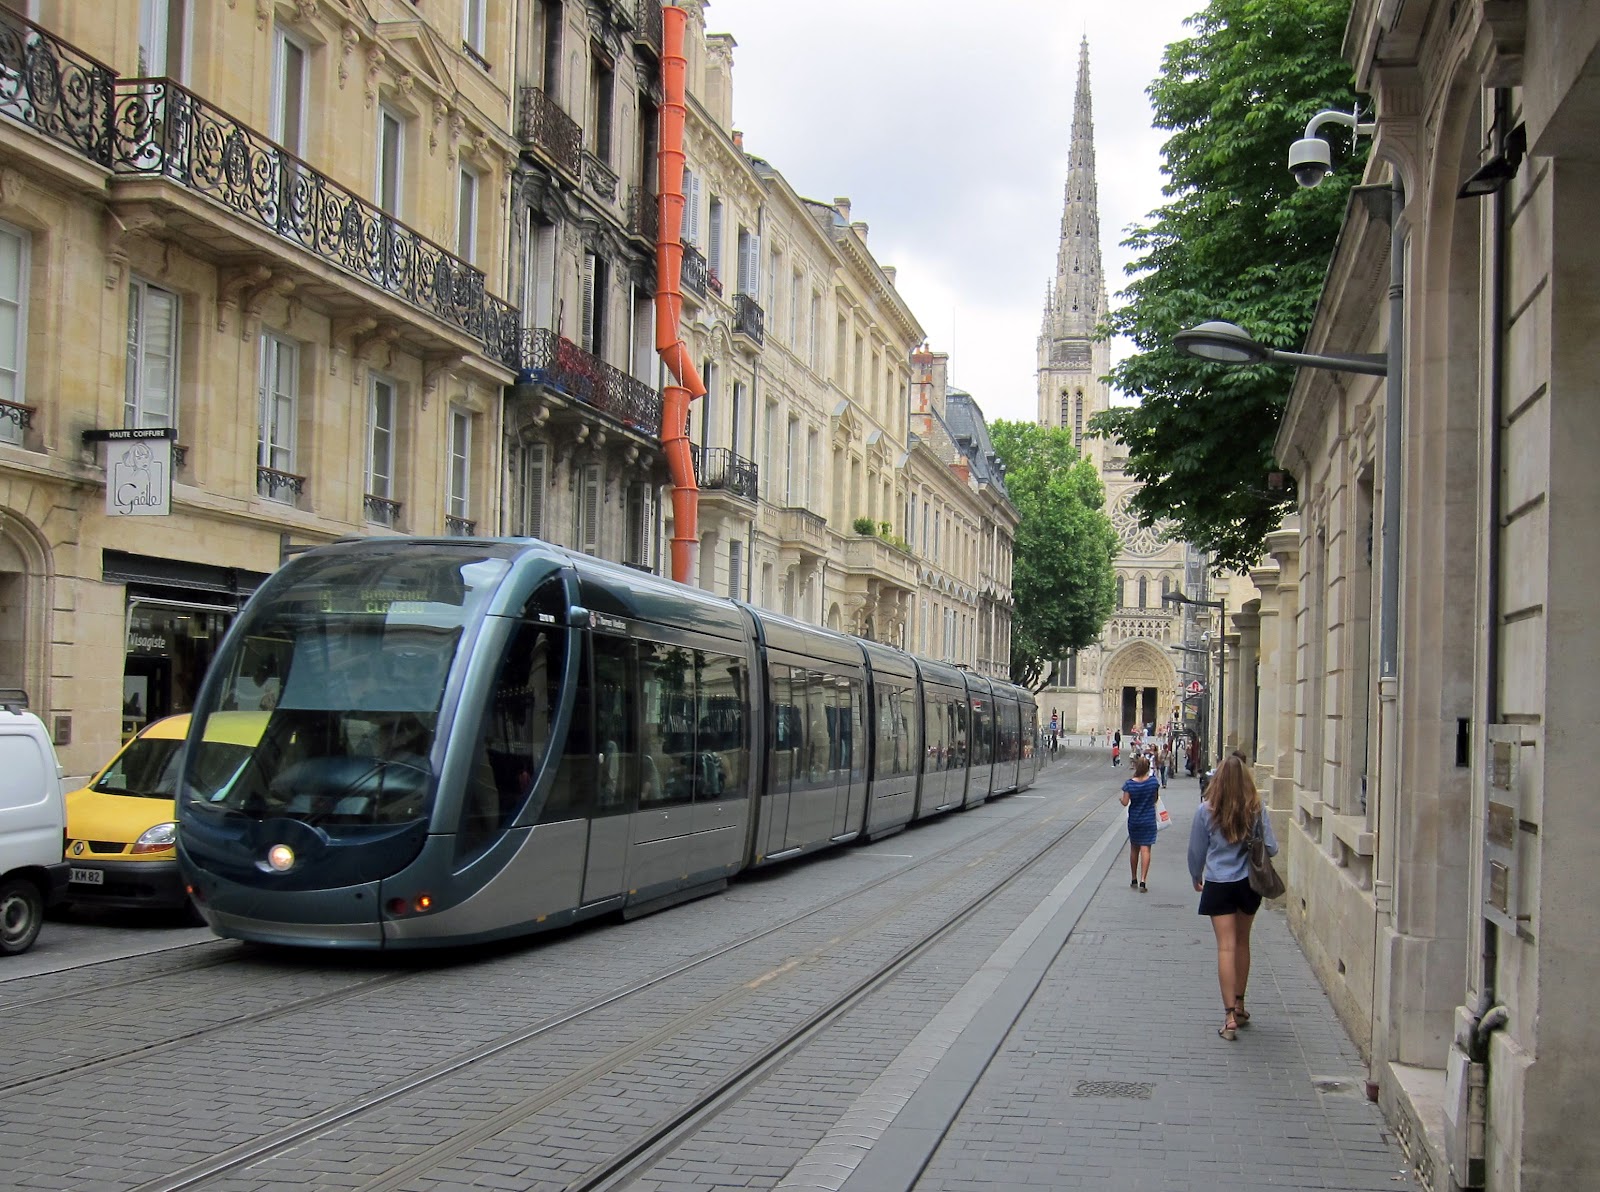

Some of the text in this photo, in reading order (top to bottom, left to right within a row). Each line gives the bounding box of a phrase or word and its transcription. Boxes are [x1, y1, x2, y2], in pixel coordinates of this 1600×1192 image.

[129, 632, 166, 651] Visagiste
[75, 870, 87, 881] KM
[89, 871, 100, 883] 82
